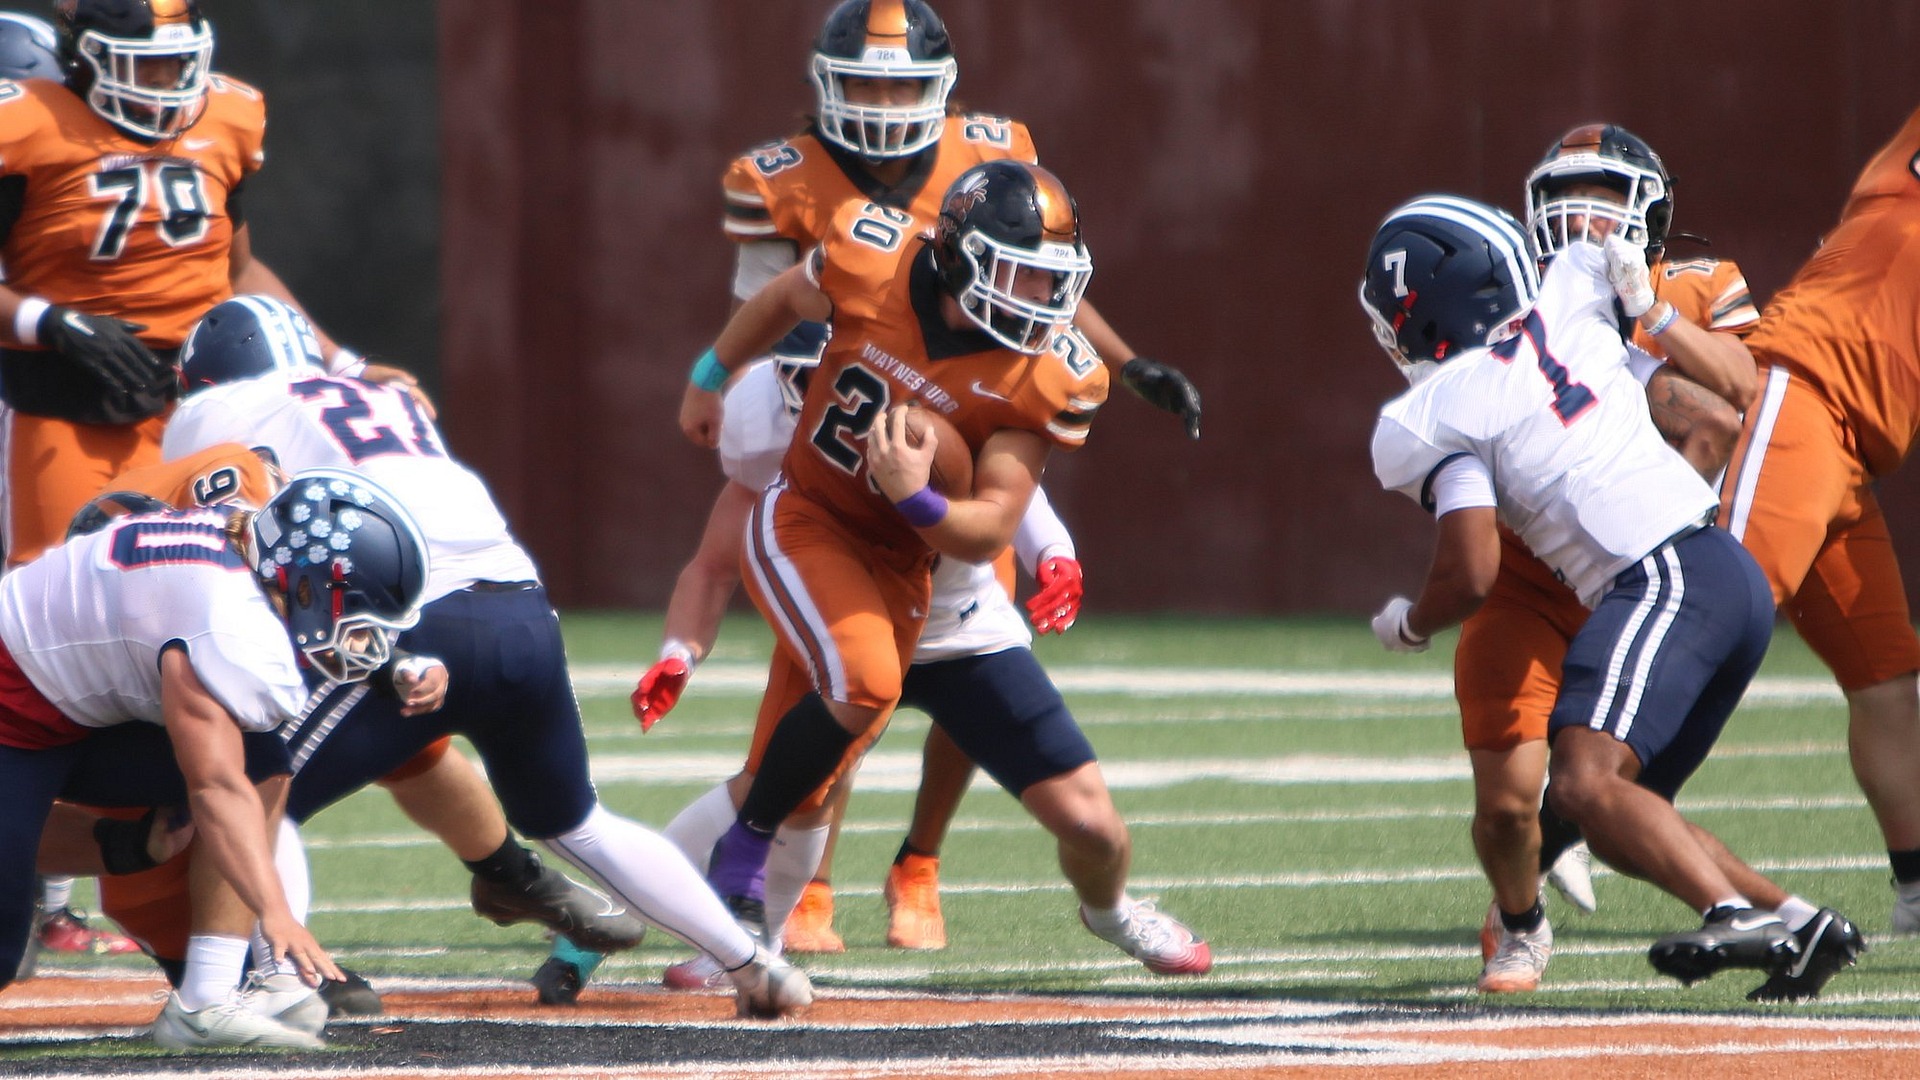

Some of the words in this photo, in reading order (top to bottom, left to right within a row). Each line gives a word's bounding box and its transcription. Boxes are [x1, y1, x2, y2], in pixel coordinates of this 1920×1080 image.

[750, 138, 803, 176] 3
[964, 112, 1011, 150] 2
[1384, 250, 1409, 298] 7
[862, 342, 959, 414] WAYNESBURG
[1051, 325, 1104, 380] 2
[287, 377, 446, 466] 27
[810, 362, 890, 494] 2
[109, 503, 252, 573] 0
